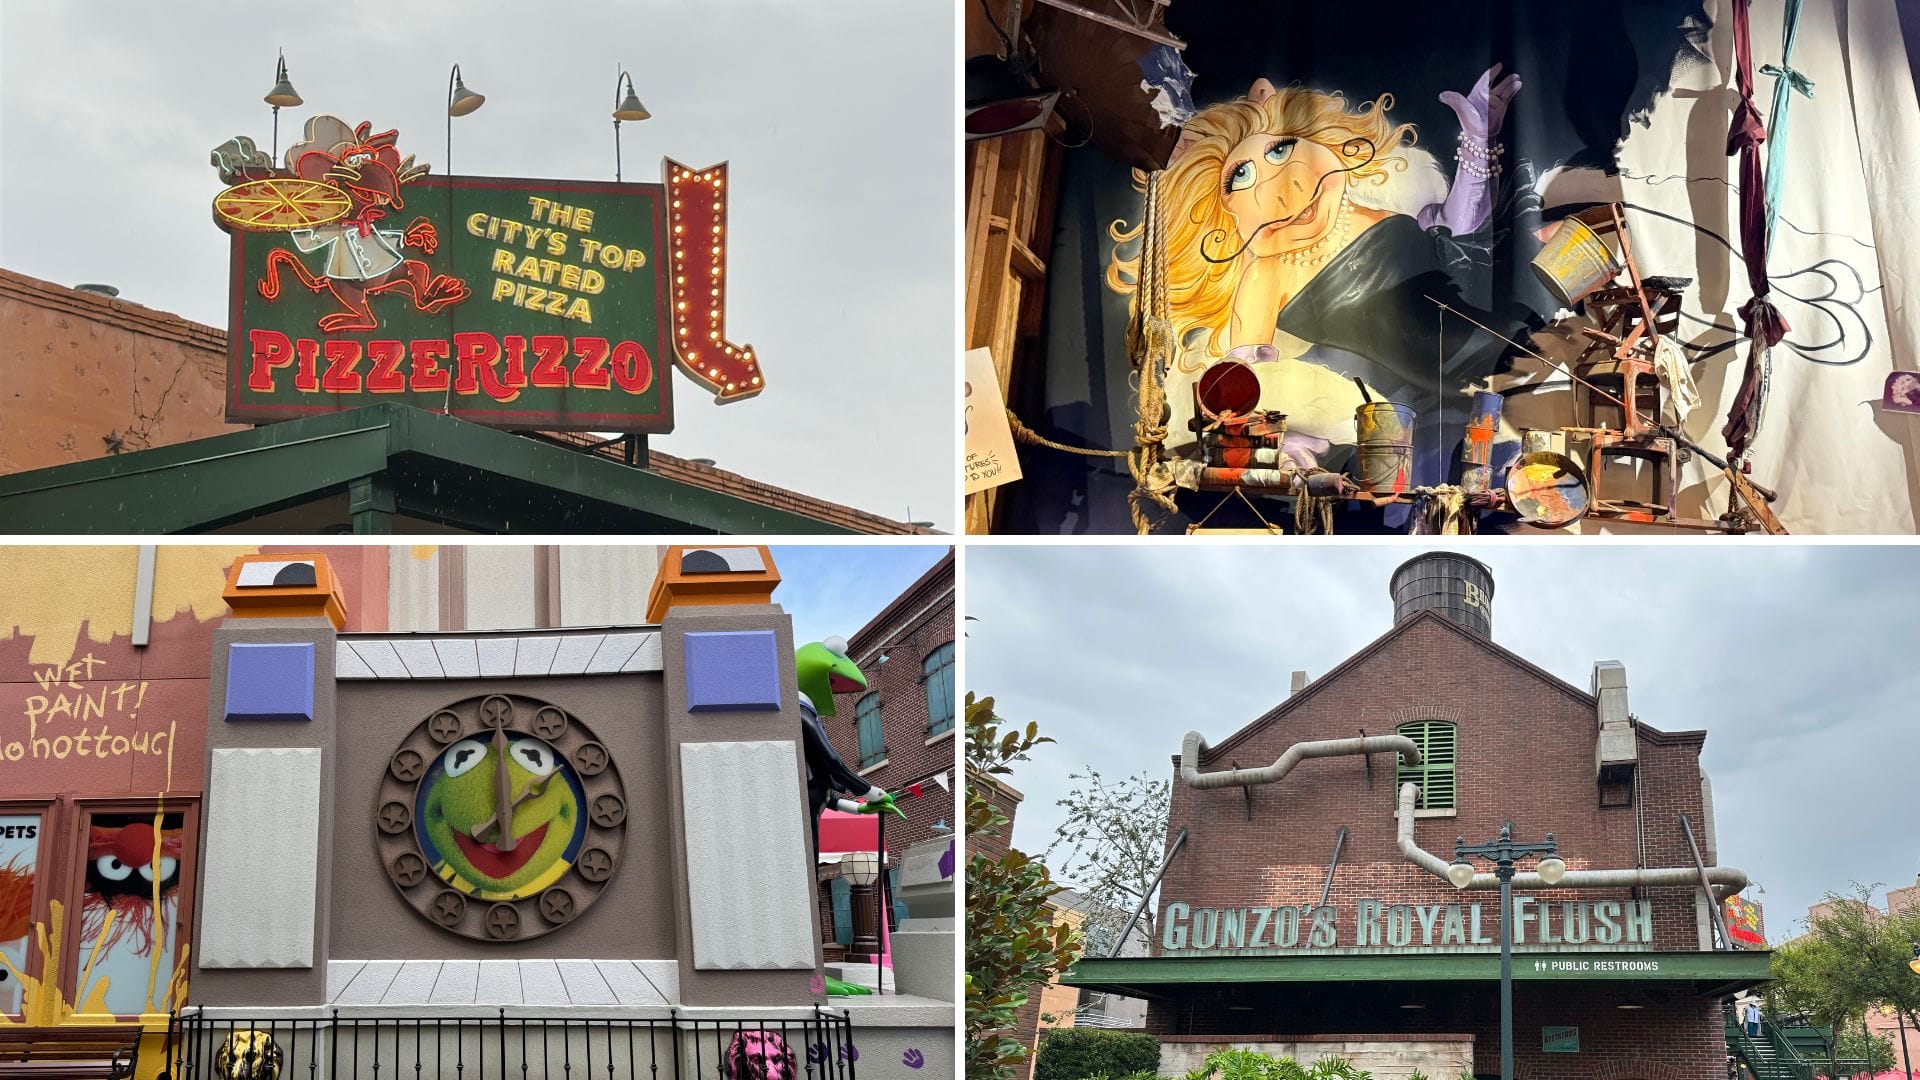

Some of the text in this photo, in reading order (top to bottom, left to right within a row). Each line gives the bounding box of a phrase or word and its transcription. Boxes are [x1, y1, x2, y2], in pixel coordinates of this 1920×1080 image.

[528, 196, 594, 233] THE
[467, 213, 647, 273] CITY'S TOP
[491, 249, 605, 294] RATED
[492, 278, 593, 324] PIZZA
[249, 329, 652, 402] PIZZERIZZO
[966, 453, 978, 462] OF
[24, 682, 149, 732] PAINT!
[0, 735, 25, 761] o
[1162, 896, 1653, 950] GONZO'S ROYAL FLUSH
[1552, 961, 1659, 971] PUBLIC RESTROOMS
